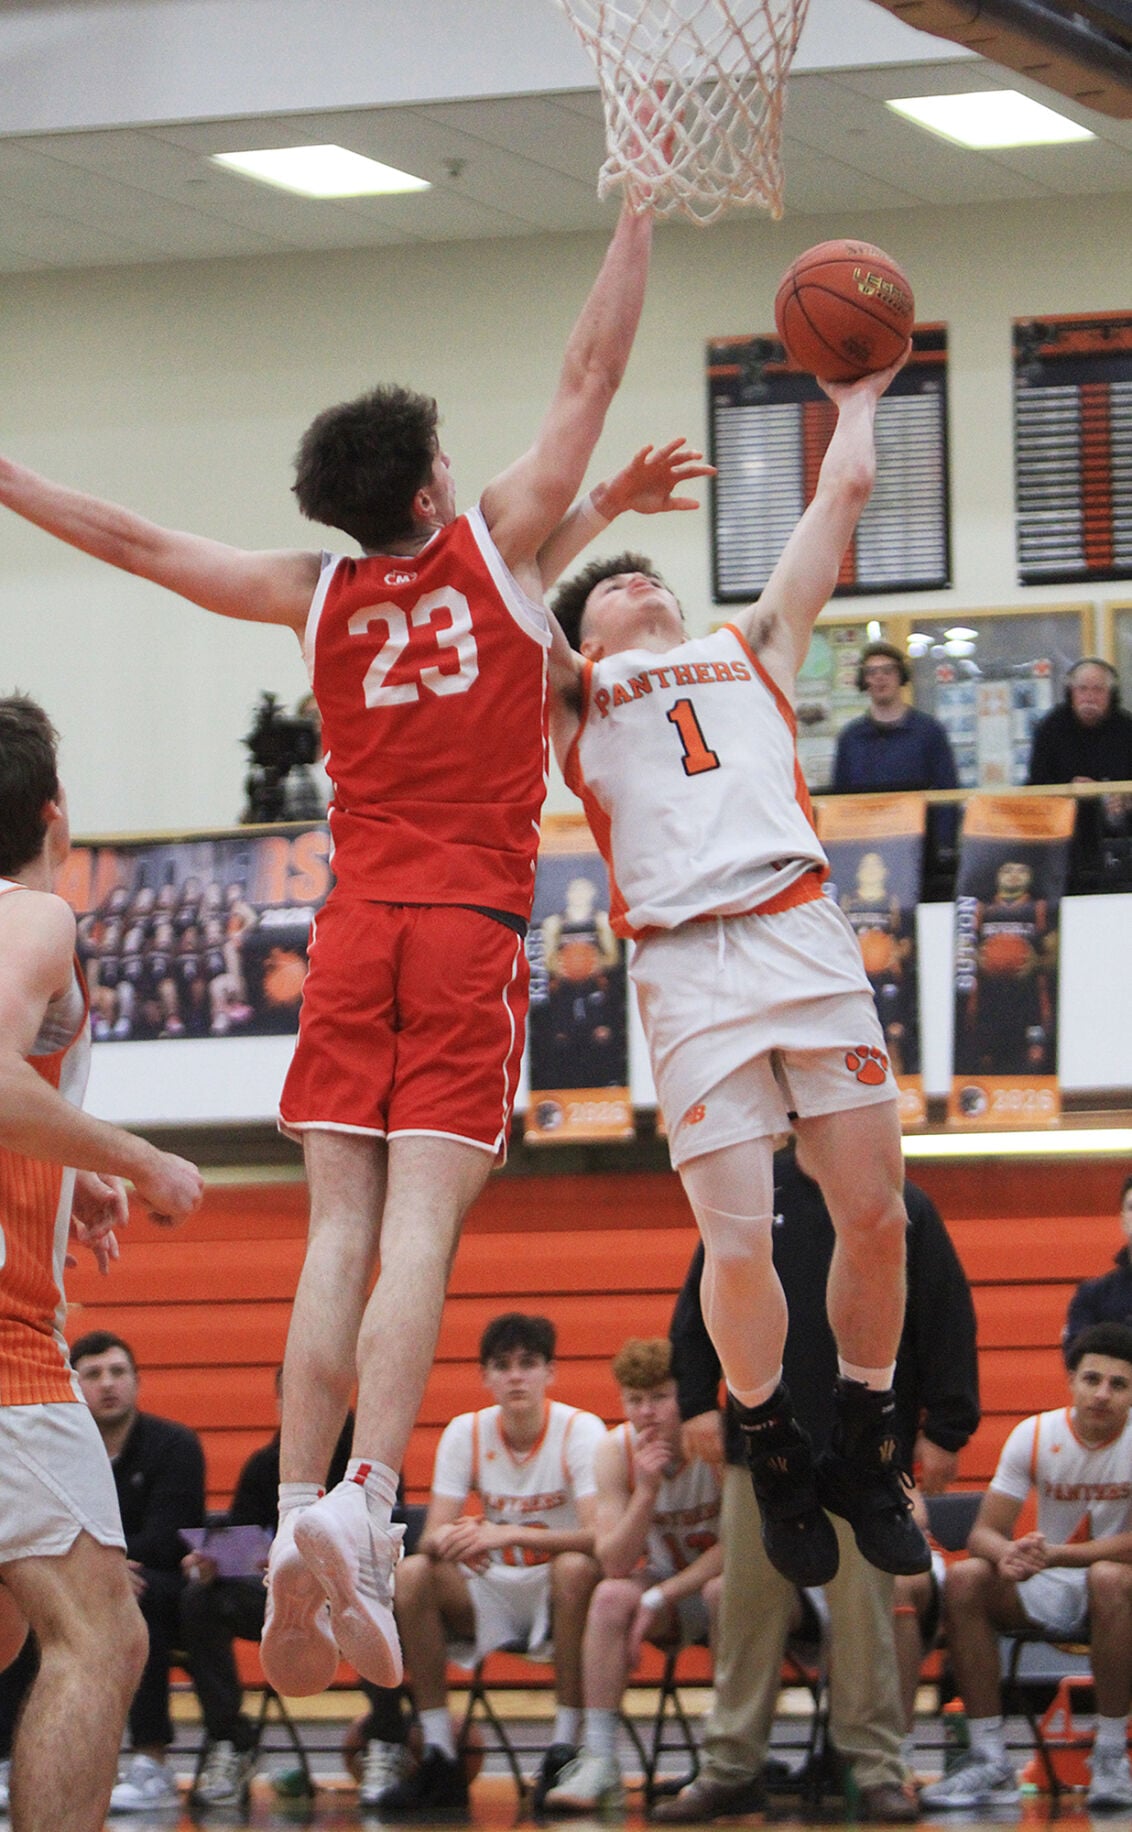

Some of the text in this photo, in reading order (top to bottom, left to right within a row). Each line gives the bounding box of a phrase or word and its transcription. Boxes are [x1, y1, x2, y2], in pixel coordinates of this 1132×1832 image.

[347, 585, 479, 709] 23
[593, 661, 752, 718] PANTHERS
[666, 698, 721, 777] 1
